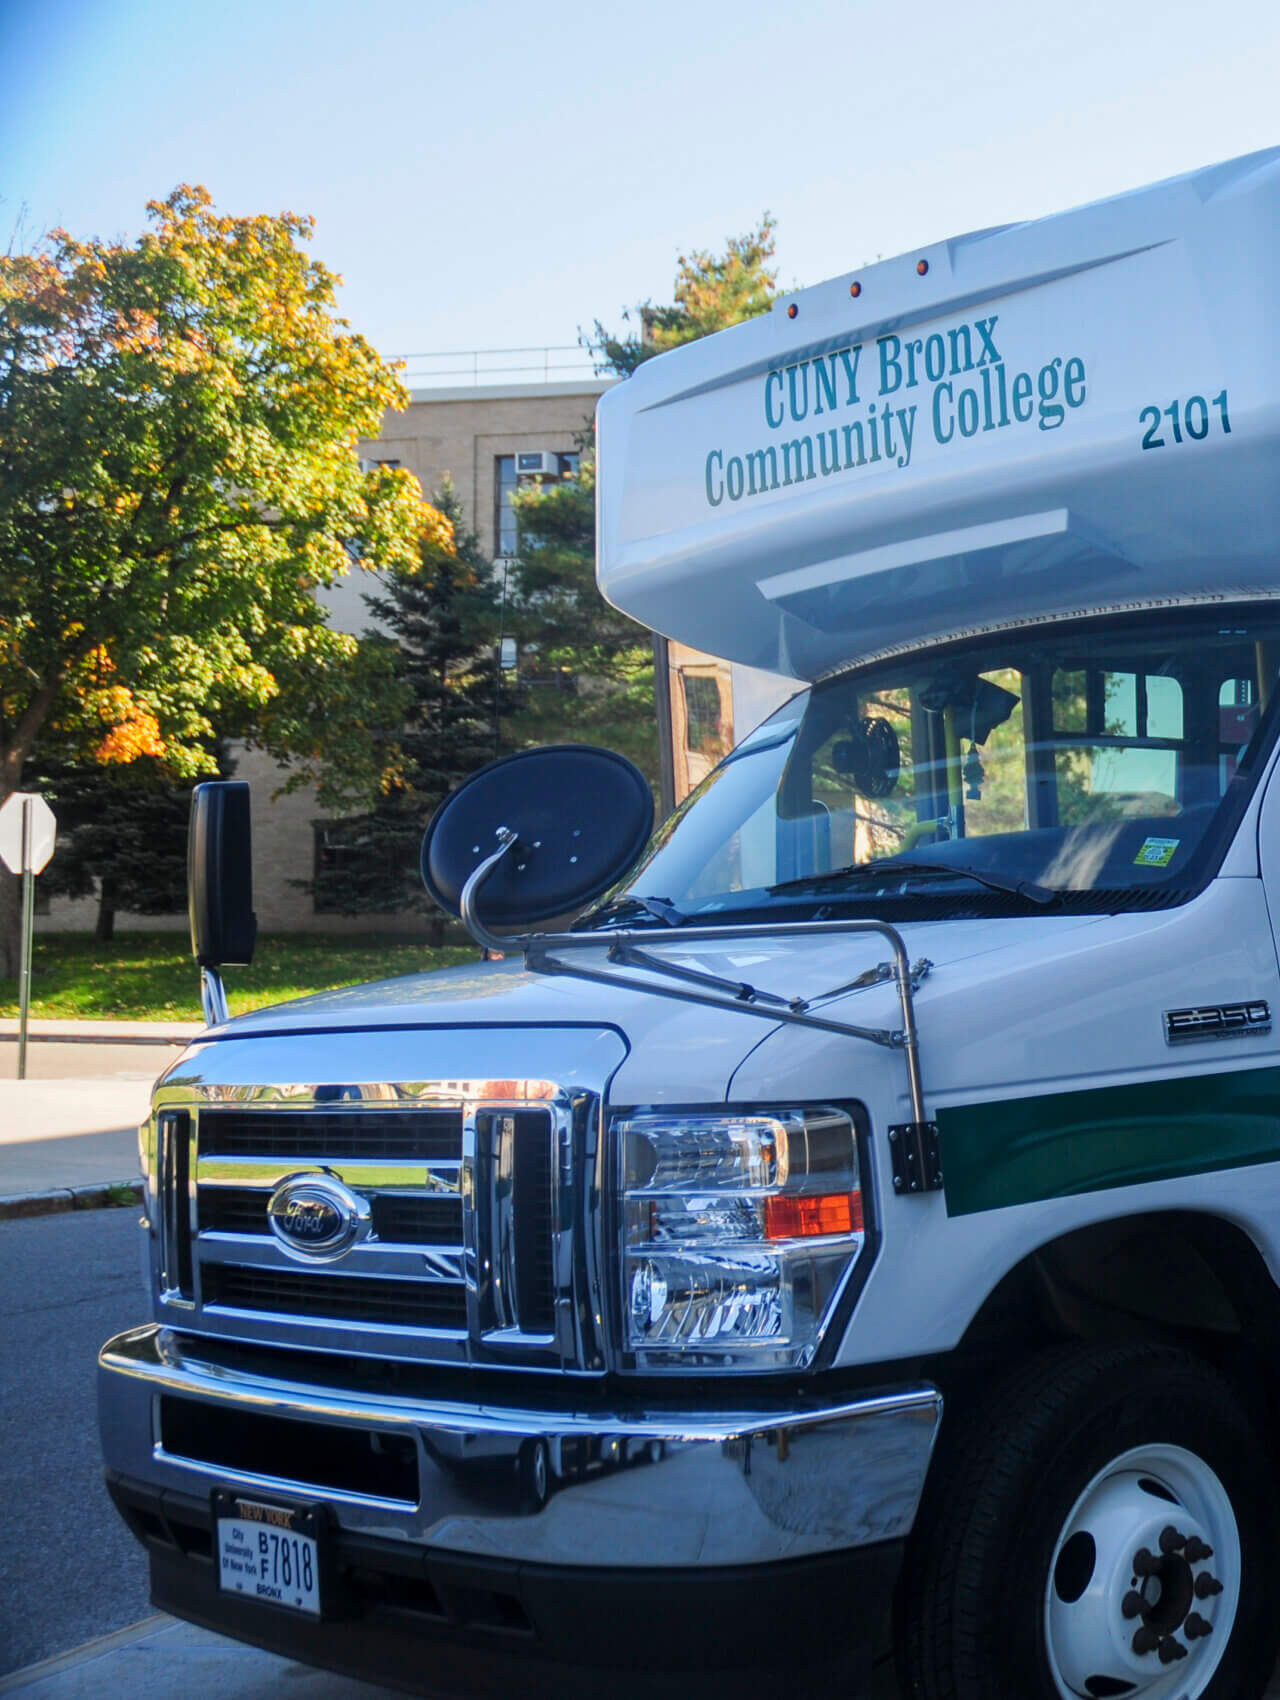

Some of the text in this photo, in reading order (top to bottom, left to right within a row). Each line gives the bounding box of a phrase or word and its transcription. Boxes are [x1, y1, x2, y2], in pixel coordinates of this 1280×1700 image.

[764, 315, 1003, 429] CUNY Bronx
[705, 356, 1087, 507] Community College
[1138, 390, 1233, 450] 2101
[282, 1199, 325, 1233] Ford
[270, 1533, 313, 1592] 7818
